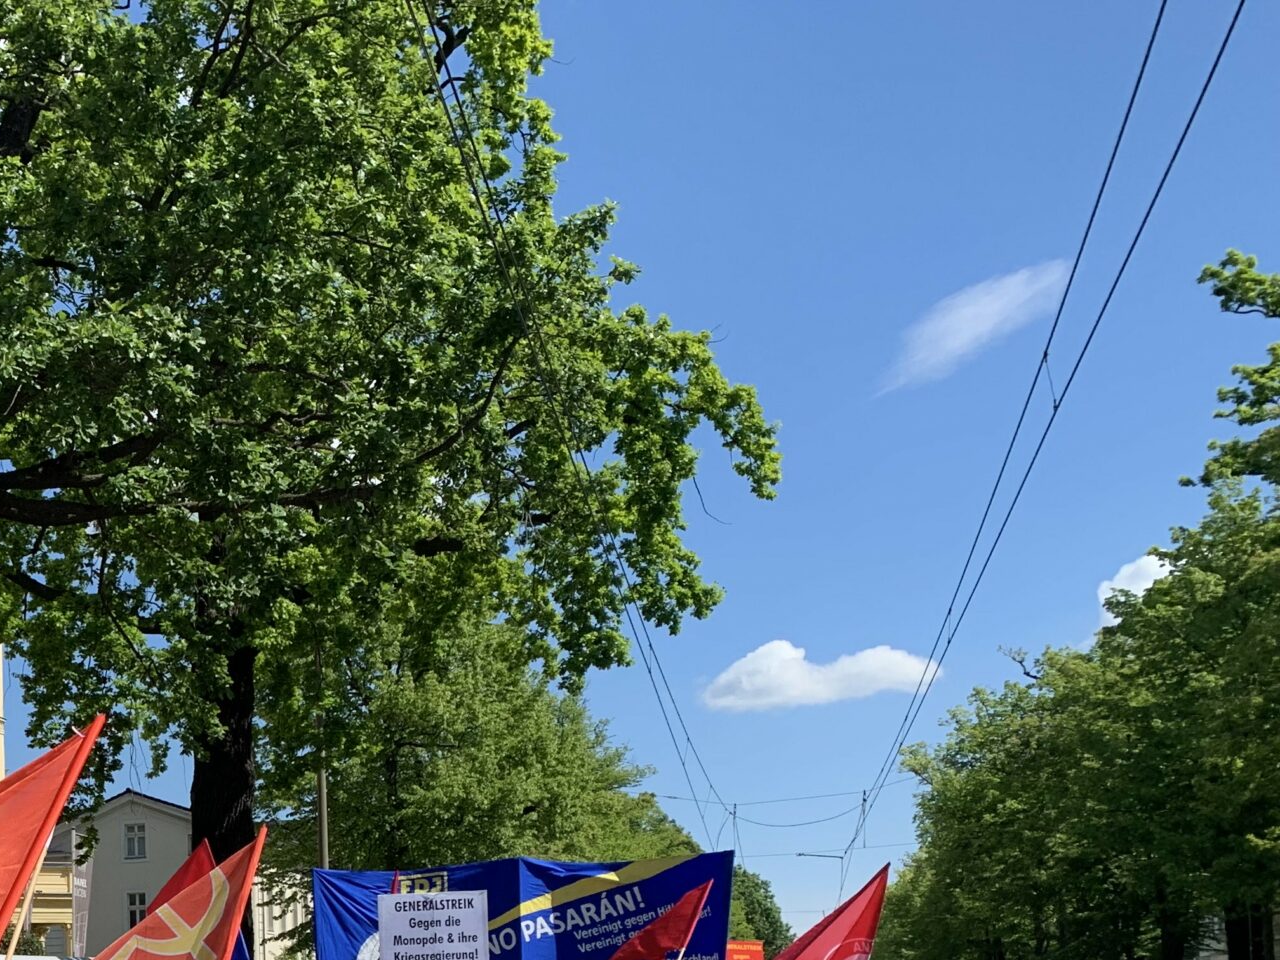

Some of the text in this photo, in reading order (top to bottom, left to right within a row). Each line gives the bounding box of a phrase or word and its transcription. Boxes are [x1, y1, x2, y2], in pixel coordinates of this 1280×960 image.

[394, 898, 475, 912] GENERALSTREIK
[520, 886, 646, 942] PASARÁN!
[408, 916, 461, 930] Gegen die
[573, 919, 622, 941] Vereinigt
[625, 910, 656, 929] gegen
[393, 932, 478, 949] Monopole & ihre
[577, 933, 627, 955] Vereinigt
